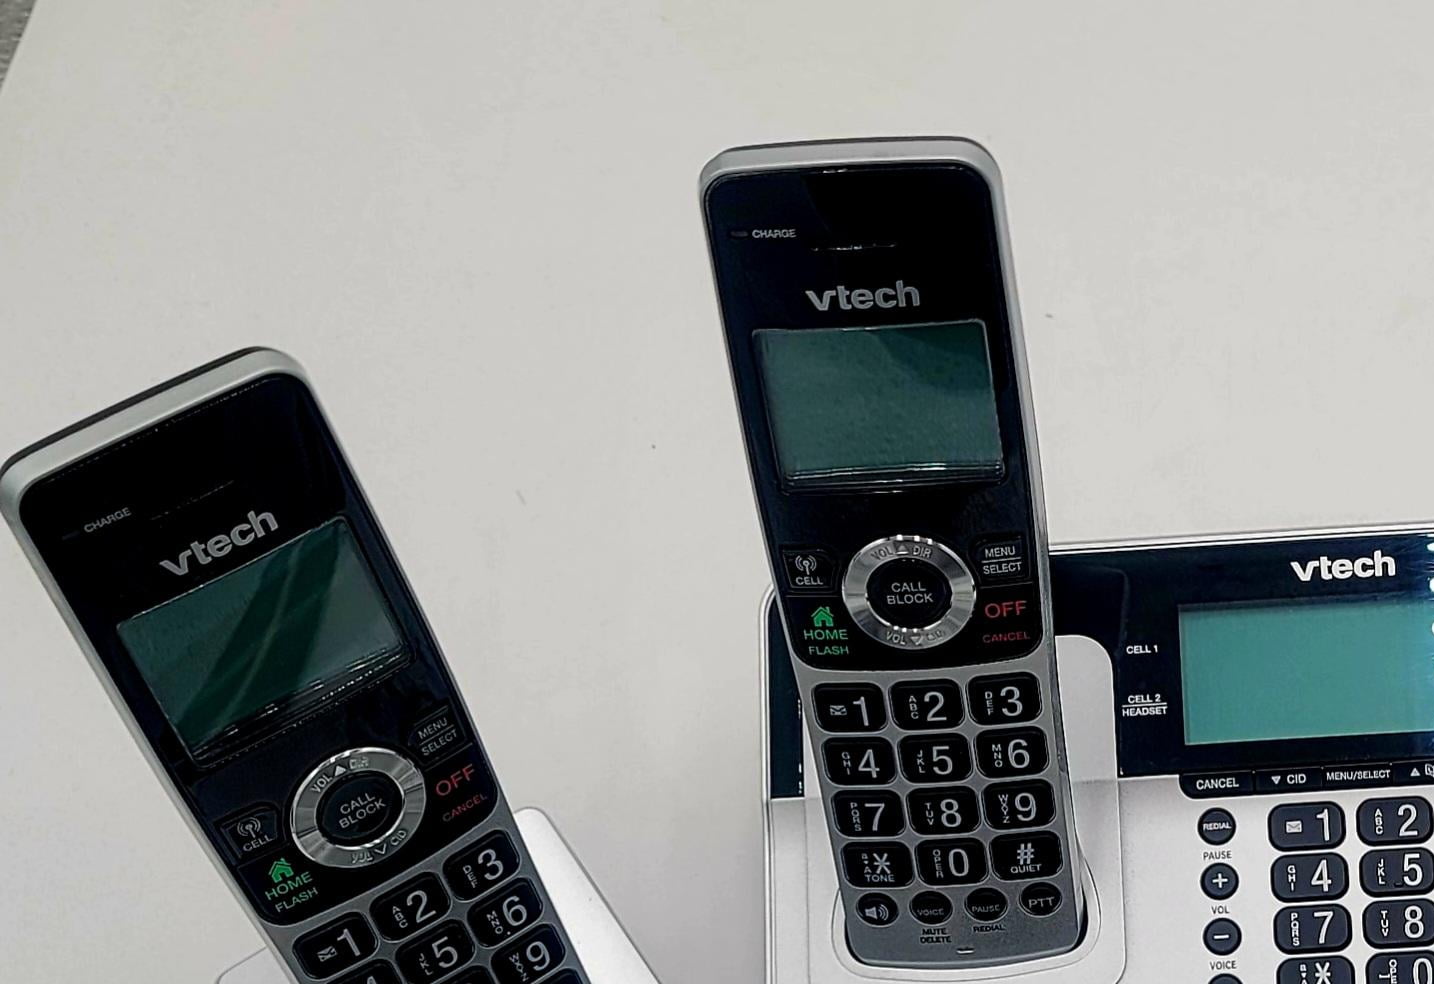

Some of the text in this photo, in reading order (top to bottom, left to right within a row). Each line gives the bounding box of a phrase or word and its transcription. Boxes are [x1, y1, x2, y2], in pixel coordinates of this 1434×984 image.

[805, 280, 920, 311] vtech
[159, 510, 279, 576] vtech
[1290, 550, 1396, 581] vtech
[891, 582, 926, 593] CALL
[886, 593, 933, 605] BLOCK
[984, 601, 1027, 619] OFF
[804, 629, 848, 641] HOME
[808, 646, 849, 656] FLASH
[1126, 645, 1151, 654] CELL
[1128, 693, 1161, 703] CELL 2
[1122, 706, 1168, 717] HEADSET
[435, 763, 475, 796] OFF
[1196, 776, 1239, 790] CANCEL
[1287, 773, 1306, 785] CID
[1326, 769, 1390, 782] MENU/SELECT
[340, 792, 376, 815] CALL
[339, 800, 387, 829] BLOCK
[1397, 803, 1418, 837] 2
[1202, 821, 1232, 831] REDIAL
[1316, 808, 1330, 842] 1
[1203, 850, 1232, 860] PAUSE
[1310, 859, 1332, 892] 4
[1402, 853, 1423, 887] 5
[265, 871, 313, 901] HOME
[1211, 905, 1230, 915] VOL
[1313, 911, 1334, 944] 7
[1403, 905, 1424, 939] 8
[1209, 960, 1237, 970] VOICE
